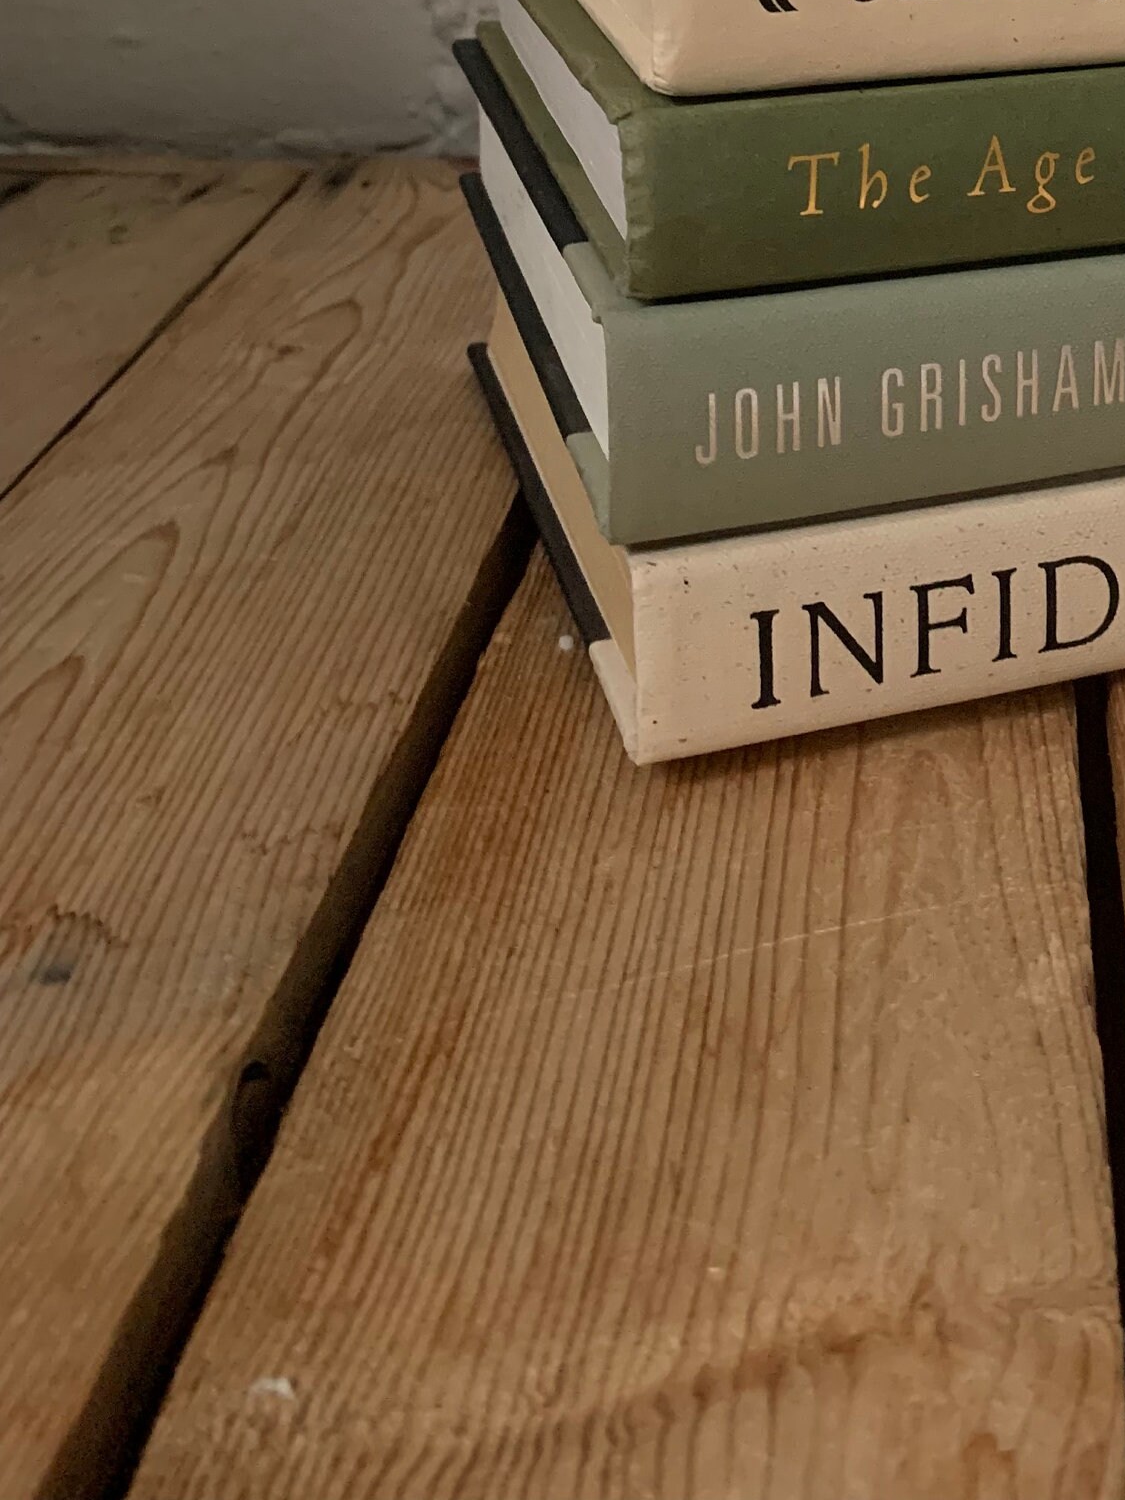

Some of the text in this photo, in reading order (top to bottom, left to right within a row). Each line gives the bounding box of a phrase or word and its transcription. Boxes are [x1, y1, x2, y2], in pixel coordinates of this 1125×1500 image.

[787, 143, 932, 216] The
[967, 134, 1096, 213] Age
[694, 376, 844, 467] JOHN
